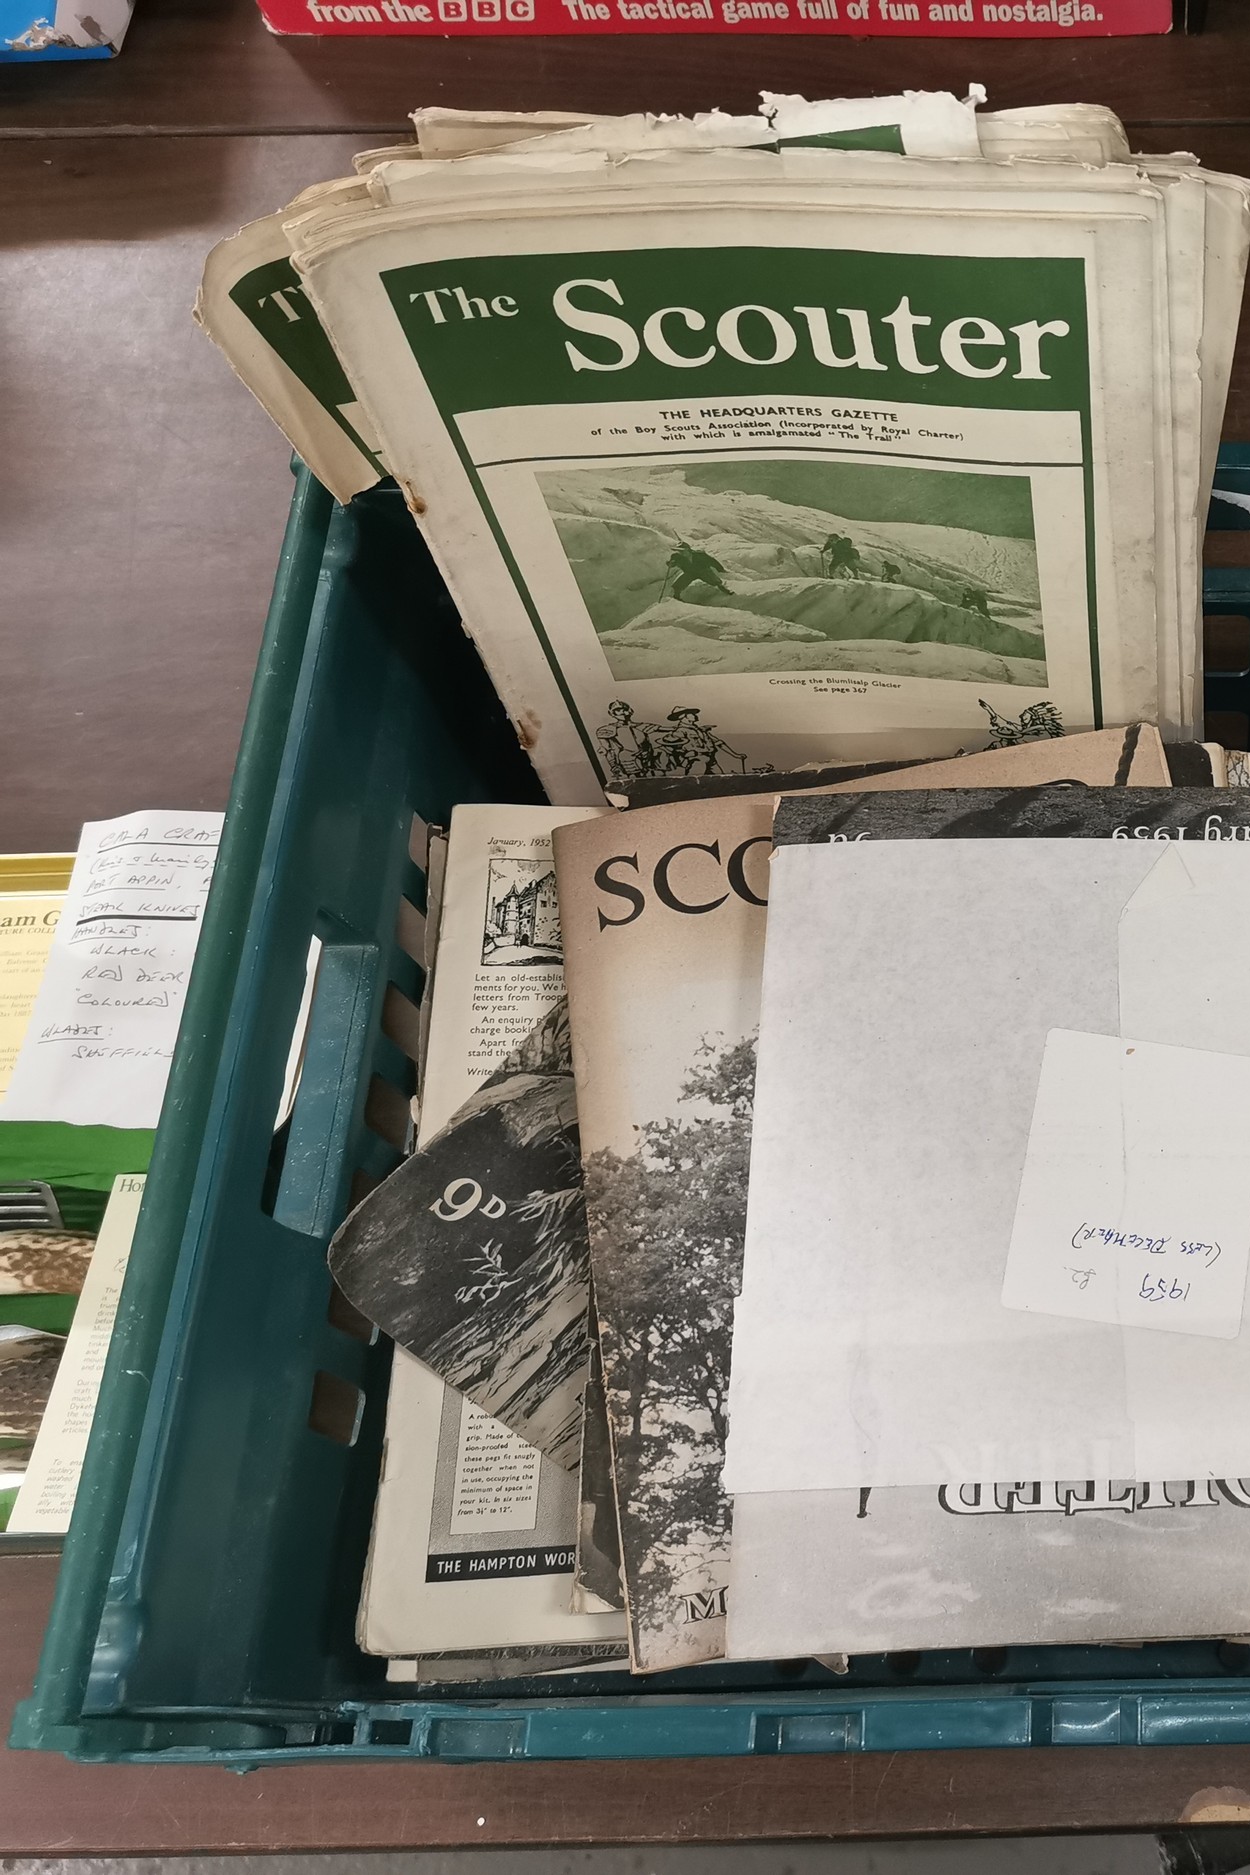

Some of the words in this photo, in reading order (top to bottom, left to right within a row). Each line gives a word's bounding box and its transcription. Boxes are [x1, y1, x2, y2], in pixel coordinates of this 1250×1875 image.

[306, 0, 383, 22] from
[383, 0, 433, 22] the
[561, 0, 611, 20] The
[618, 0, 714, 20] tactical
[722, 1, 790, 24] game
[798, 0, 839, 20] full
[846, 0, 870, 20] of
[878, 0, 920, 21] fun
[928, 0, 974, 22] and
[983, 0, 1104, 27] nostalgia.
[409, 287, 519, 325] The
[551, 278, 1070, 380] Scouter
[659, 410, 690, 420] THE
[700, 407, 822, 418] HEADQUARTERS
[832, 409, 898, 421] GAZETTE
[591, 428, 601, 436] of
[610, 427, 627, 435] the
[635, 426, 656, 435] Boy
[664, 424, 700, 432] Scouts
[708, 420, 771, 430] Association
[779, 420, 854, 431] (Incorporated
[861, 424, 873, 434] by
[881, 426, 910, 437] Royal
[918, 429, 963, 441] Charter)
[661, 433, 685, 441] with
[693, 431, 726, 440] which
[733, 430, 742, 438] is
[749, 429, 821, 439] amalgamated
[872, 680, 901, 688] Glacier
[487, 837, 525, 847] January,
[472, 1003, 488, 1011] few
[492, 1005, 518, 1013] years.
[498, 1017, 533, 1025] enquiry
[470, 1026, 501, 1036] charge
[480, 1039, 506, 1048] Apart
[496, 1049, 511, 1057] the
[467, 1068, 493, 1076] Write
[1139, 1273, 1192, 1301] 1959
[465, 1443, 508, 1452] sion-proofed
[514, 1452, 535, 1460] snugly
[486, 1475, 520, 1483] occupying
[437, 1559, 461, 1574] THE
[469, 1554, 536, 1572] HAMPTON
